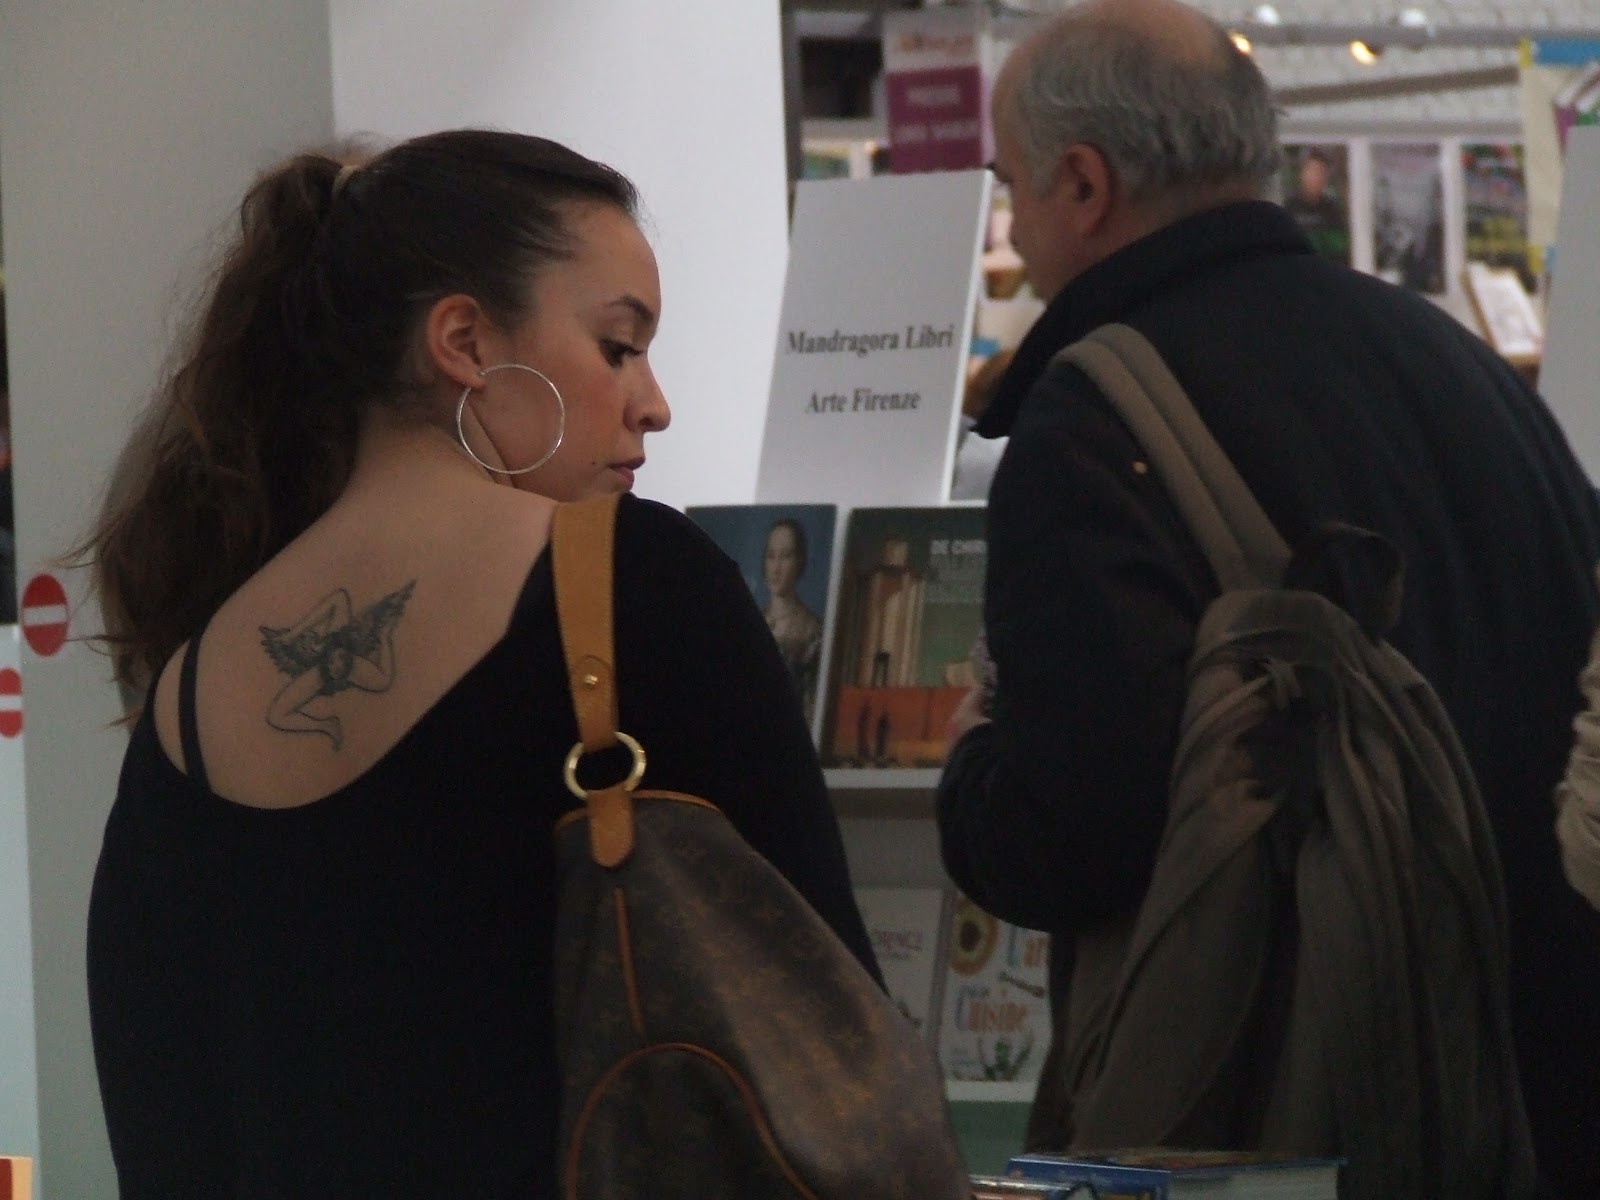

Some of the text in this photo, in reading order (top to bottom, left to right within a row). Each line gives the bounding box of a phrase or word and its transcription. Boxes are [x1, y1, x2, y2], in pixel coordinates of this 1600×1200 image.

[786, 324, 955, 358] Mandragora Libri
[805, 388, 921, 413] Arte Firenze
